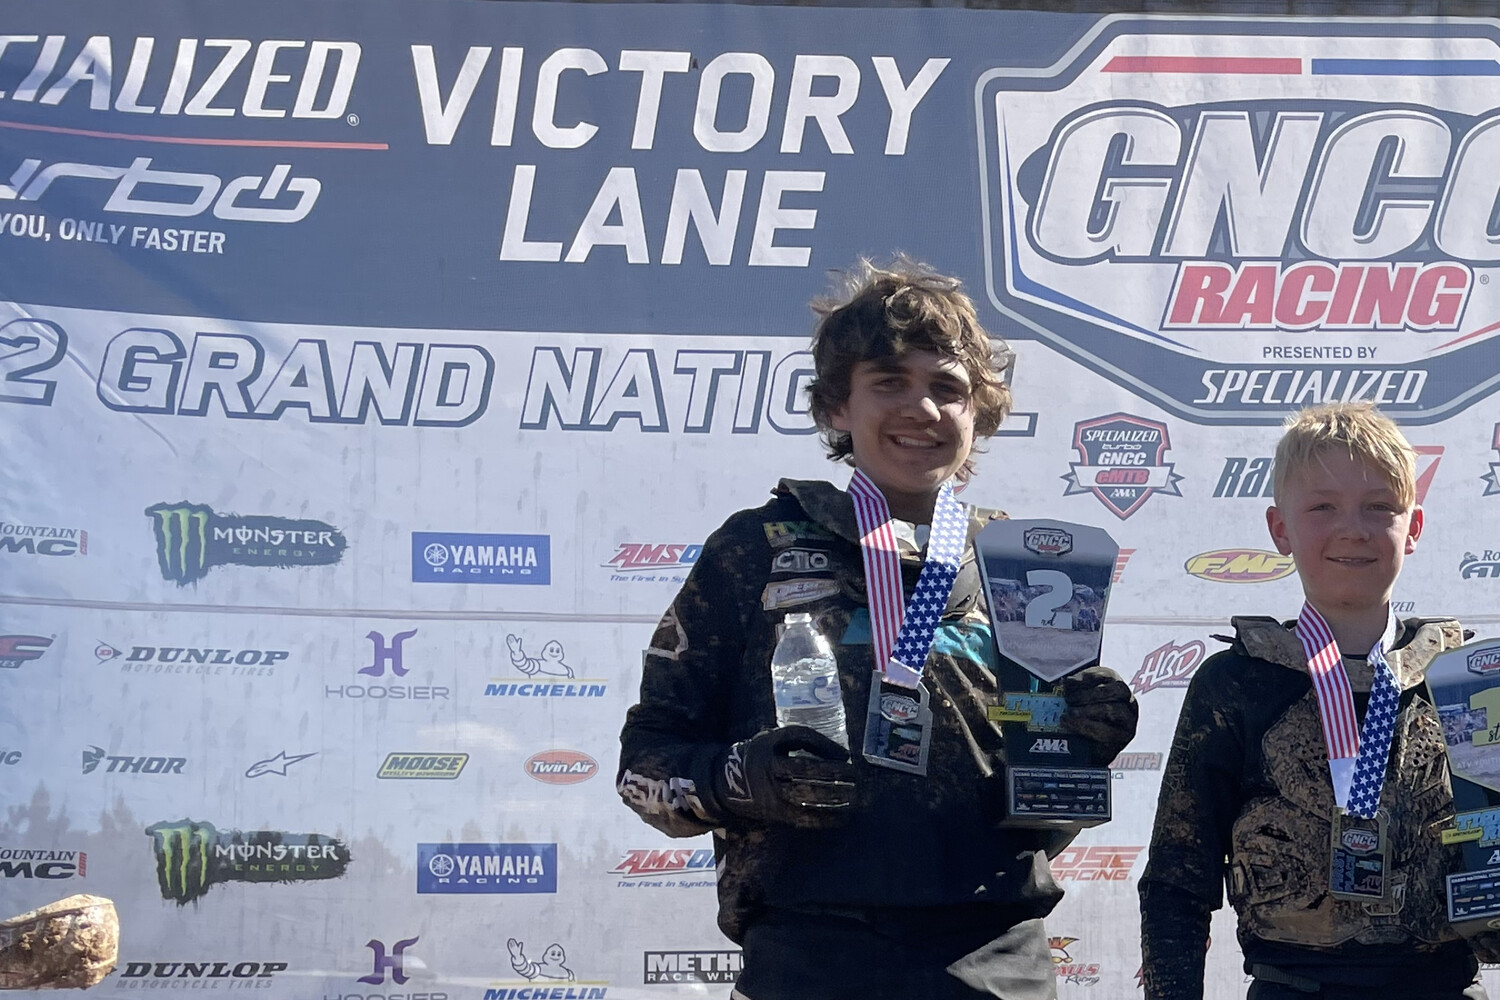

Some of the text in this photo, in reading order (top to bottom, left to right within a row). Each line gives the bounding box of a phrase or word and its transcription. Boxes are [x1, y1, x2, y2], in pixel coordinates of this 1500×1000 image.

[410, 45, 951, 155] VICTORY
[500, 165, 826, 267] LANE
[59, 217, 125, 245] ONLY
[131, 226, 226, 255] FASTER
[1164, 263, 1470, 330] RACING
[1262, 345, 1378, 360] PRESENTED BY
[97, 327, 1037, 438] GRAND NATIO
[1195, 368, 1429, 405] SPECIALIZED
[1083, 429, 1159, 442] SPECIALIZED
[1097, 451, 1147, 465] GNCC
[213, 526, 336, 548] MONSTER
[1028, 534, 1070, 546] GNCC
[232, 547, 317, 558] ENERGY
[451, 545, 538, 568] YAMAHA
[433, 567, 532, 575] RACING
[1187, 553, 1295, 575] FMF
[1025, 569, 1073, 630] 2
[125, 645, 290, 666] DUNLOP
[120, 663, 275, 677] MOTORCYCLE TIRES
[325, 685, 450, 700] HOOSIER
[484, 683, 607, 697] MICHELIN
[884, 699, 919, 717] GNCC
[1028, 738, 1071, 754] AMA
[105, 755, 187, 774] THOR
[386, 755, 468, 771] MOOSE
[530, 760, 595, 774] Twin Air
[1344, 832, 1377, 845] GNCC
[215, 844, 340, 861] MONSTER
[235, 863, 321, 872] ENERGY
[456, 855, 544, 876] YAMAHA
[120, 961, 288, 979] DUNLOP
[647, 972, 695, 982] RACE
[116, 979, 273, 990] MOTORCYCLE TIRES
[483, 987, 608, 1000] MICHELIN
